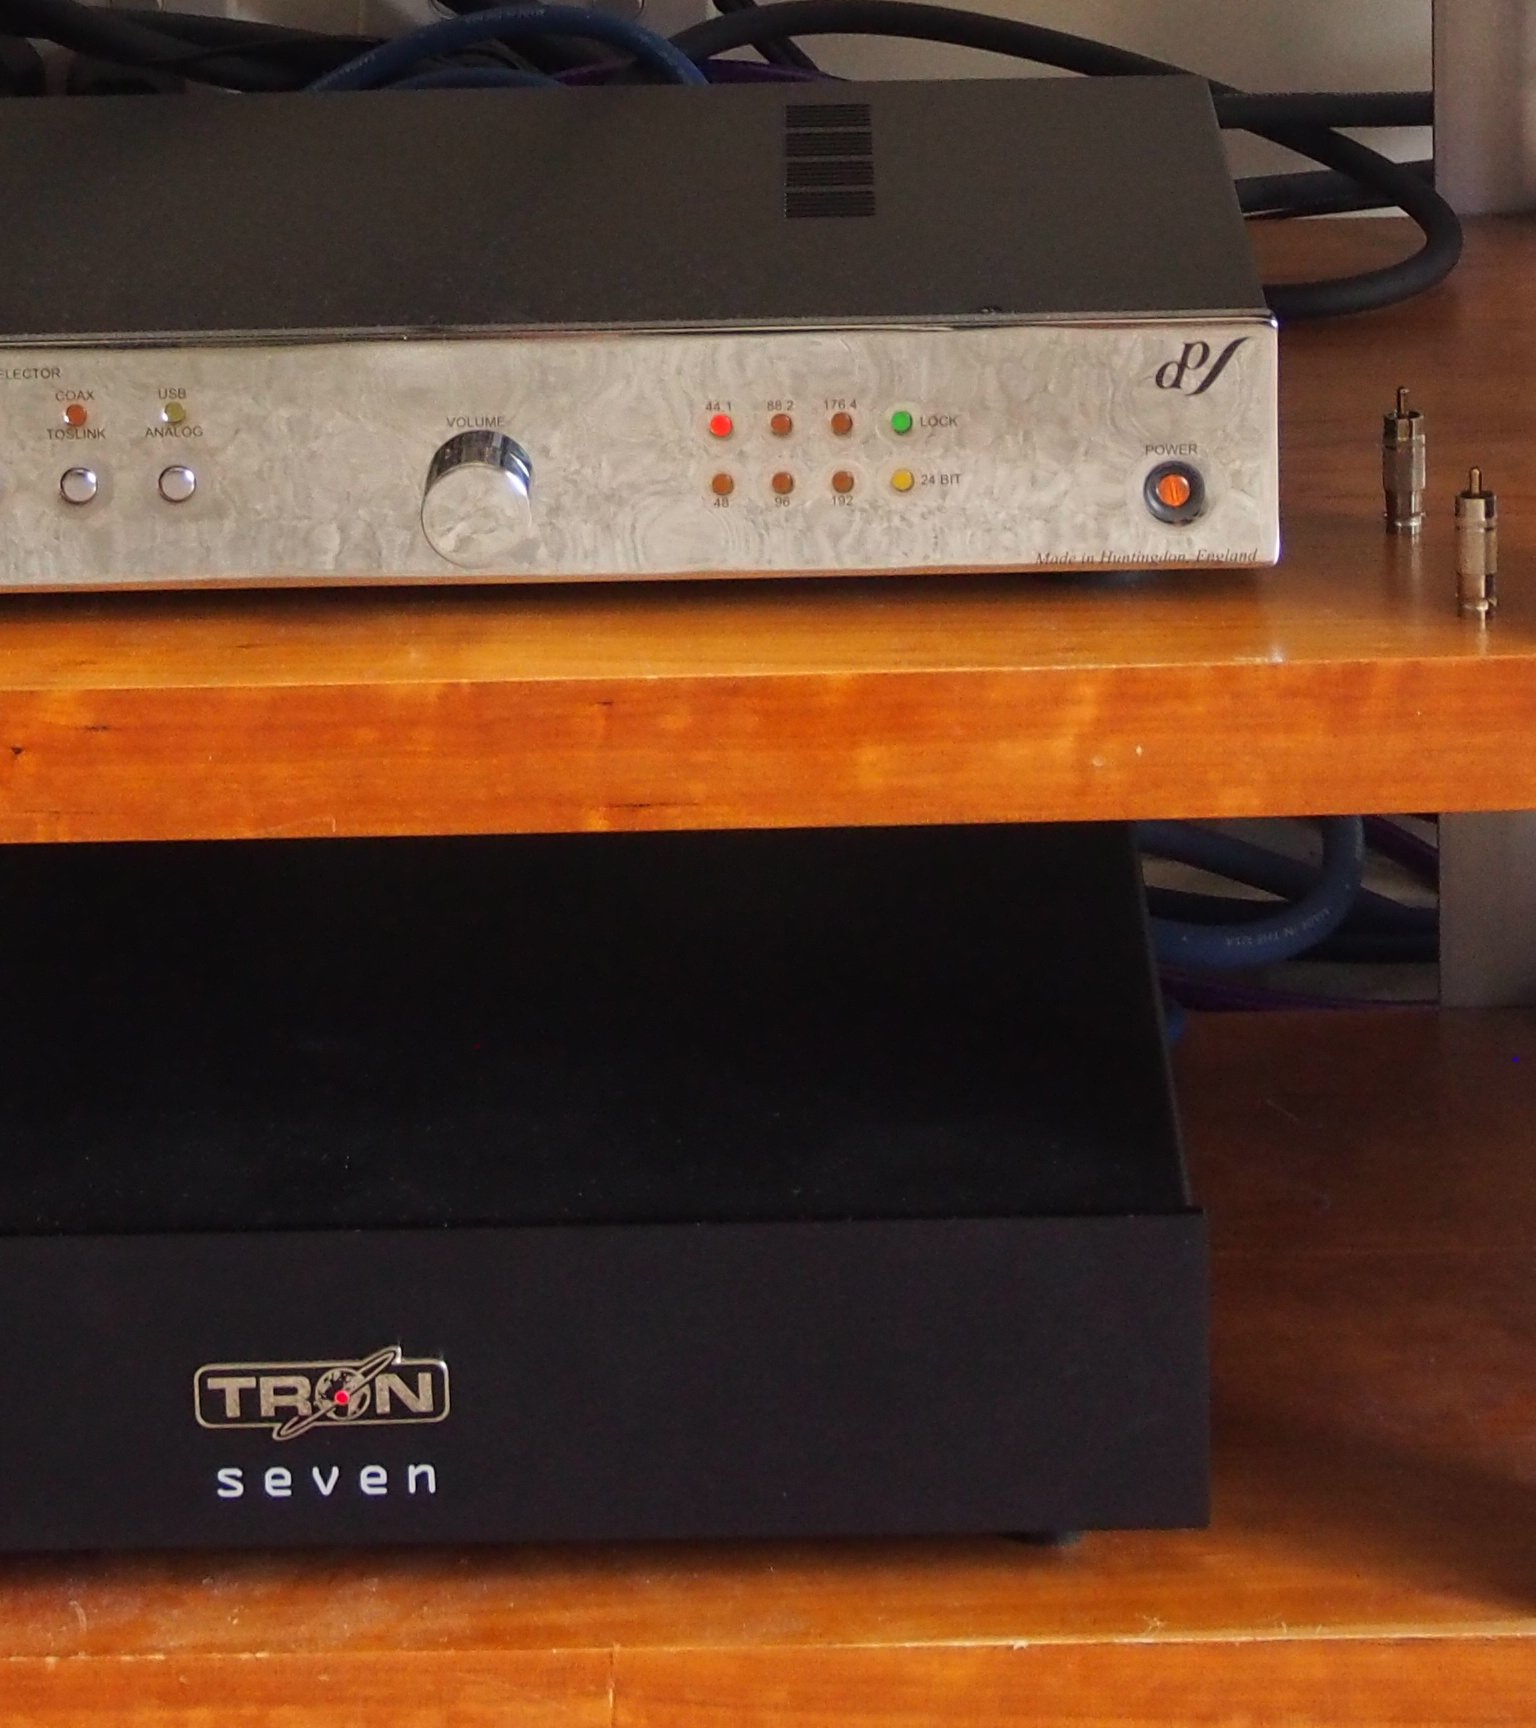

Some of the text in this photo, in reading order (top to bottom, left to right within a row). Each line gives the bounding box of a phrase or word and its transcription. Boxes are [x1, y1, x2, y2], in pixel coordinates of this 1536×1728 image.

[55, 390, 95, 401] COAX
[158, 388, 187, 400] USB
[446, 416, 505, 428] VOLUME
[920, 416, 959, 428] LOCK
[47, 428, 106, 440] TOSLINK
[145, 425, 203, 438] ANALOG
[1145, 443, 1198, 456] POWER
[920, 474, 962, 485] 24 BIT
[714, 498, 729, 508] 48
[831, 495, 854, 506] 192
[1036, 552, 1077, 565] Made
[1081, 552, 1095, 564] in
[1196, 548, 1259, 563] England
[207, 1367, 434, 1420] TRON
[216, 1463, 436, 1498] seven
